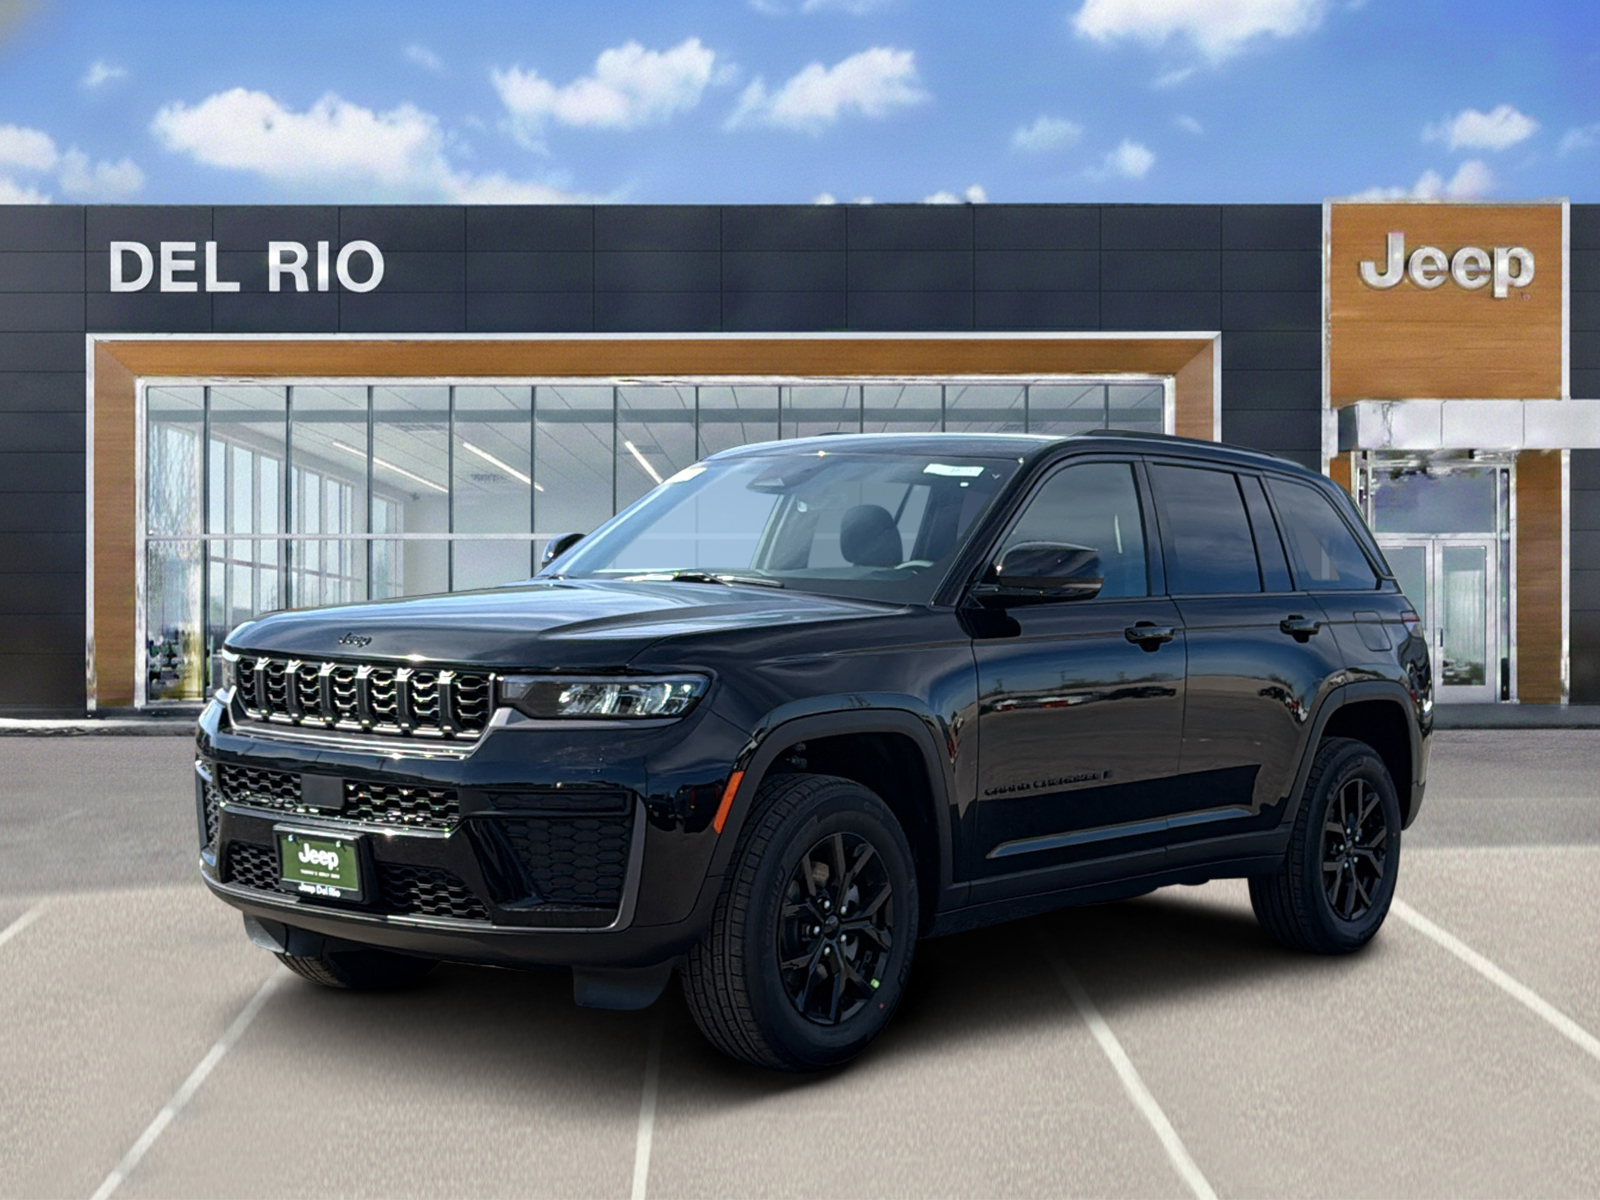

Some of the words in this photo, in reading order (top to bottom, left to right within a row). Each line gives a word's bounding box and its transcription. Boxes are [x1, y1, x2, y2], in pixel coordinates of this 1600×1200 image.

[110, 241, 241, 293] DEL
[268, 240, 385, 293] RIO
[1359, 231, 1535, 298] Jeep
[338, 631, 372, 648] Jeep
[298, 843, 339, 870] Jeep
